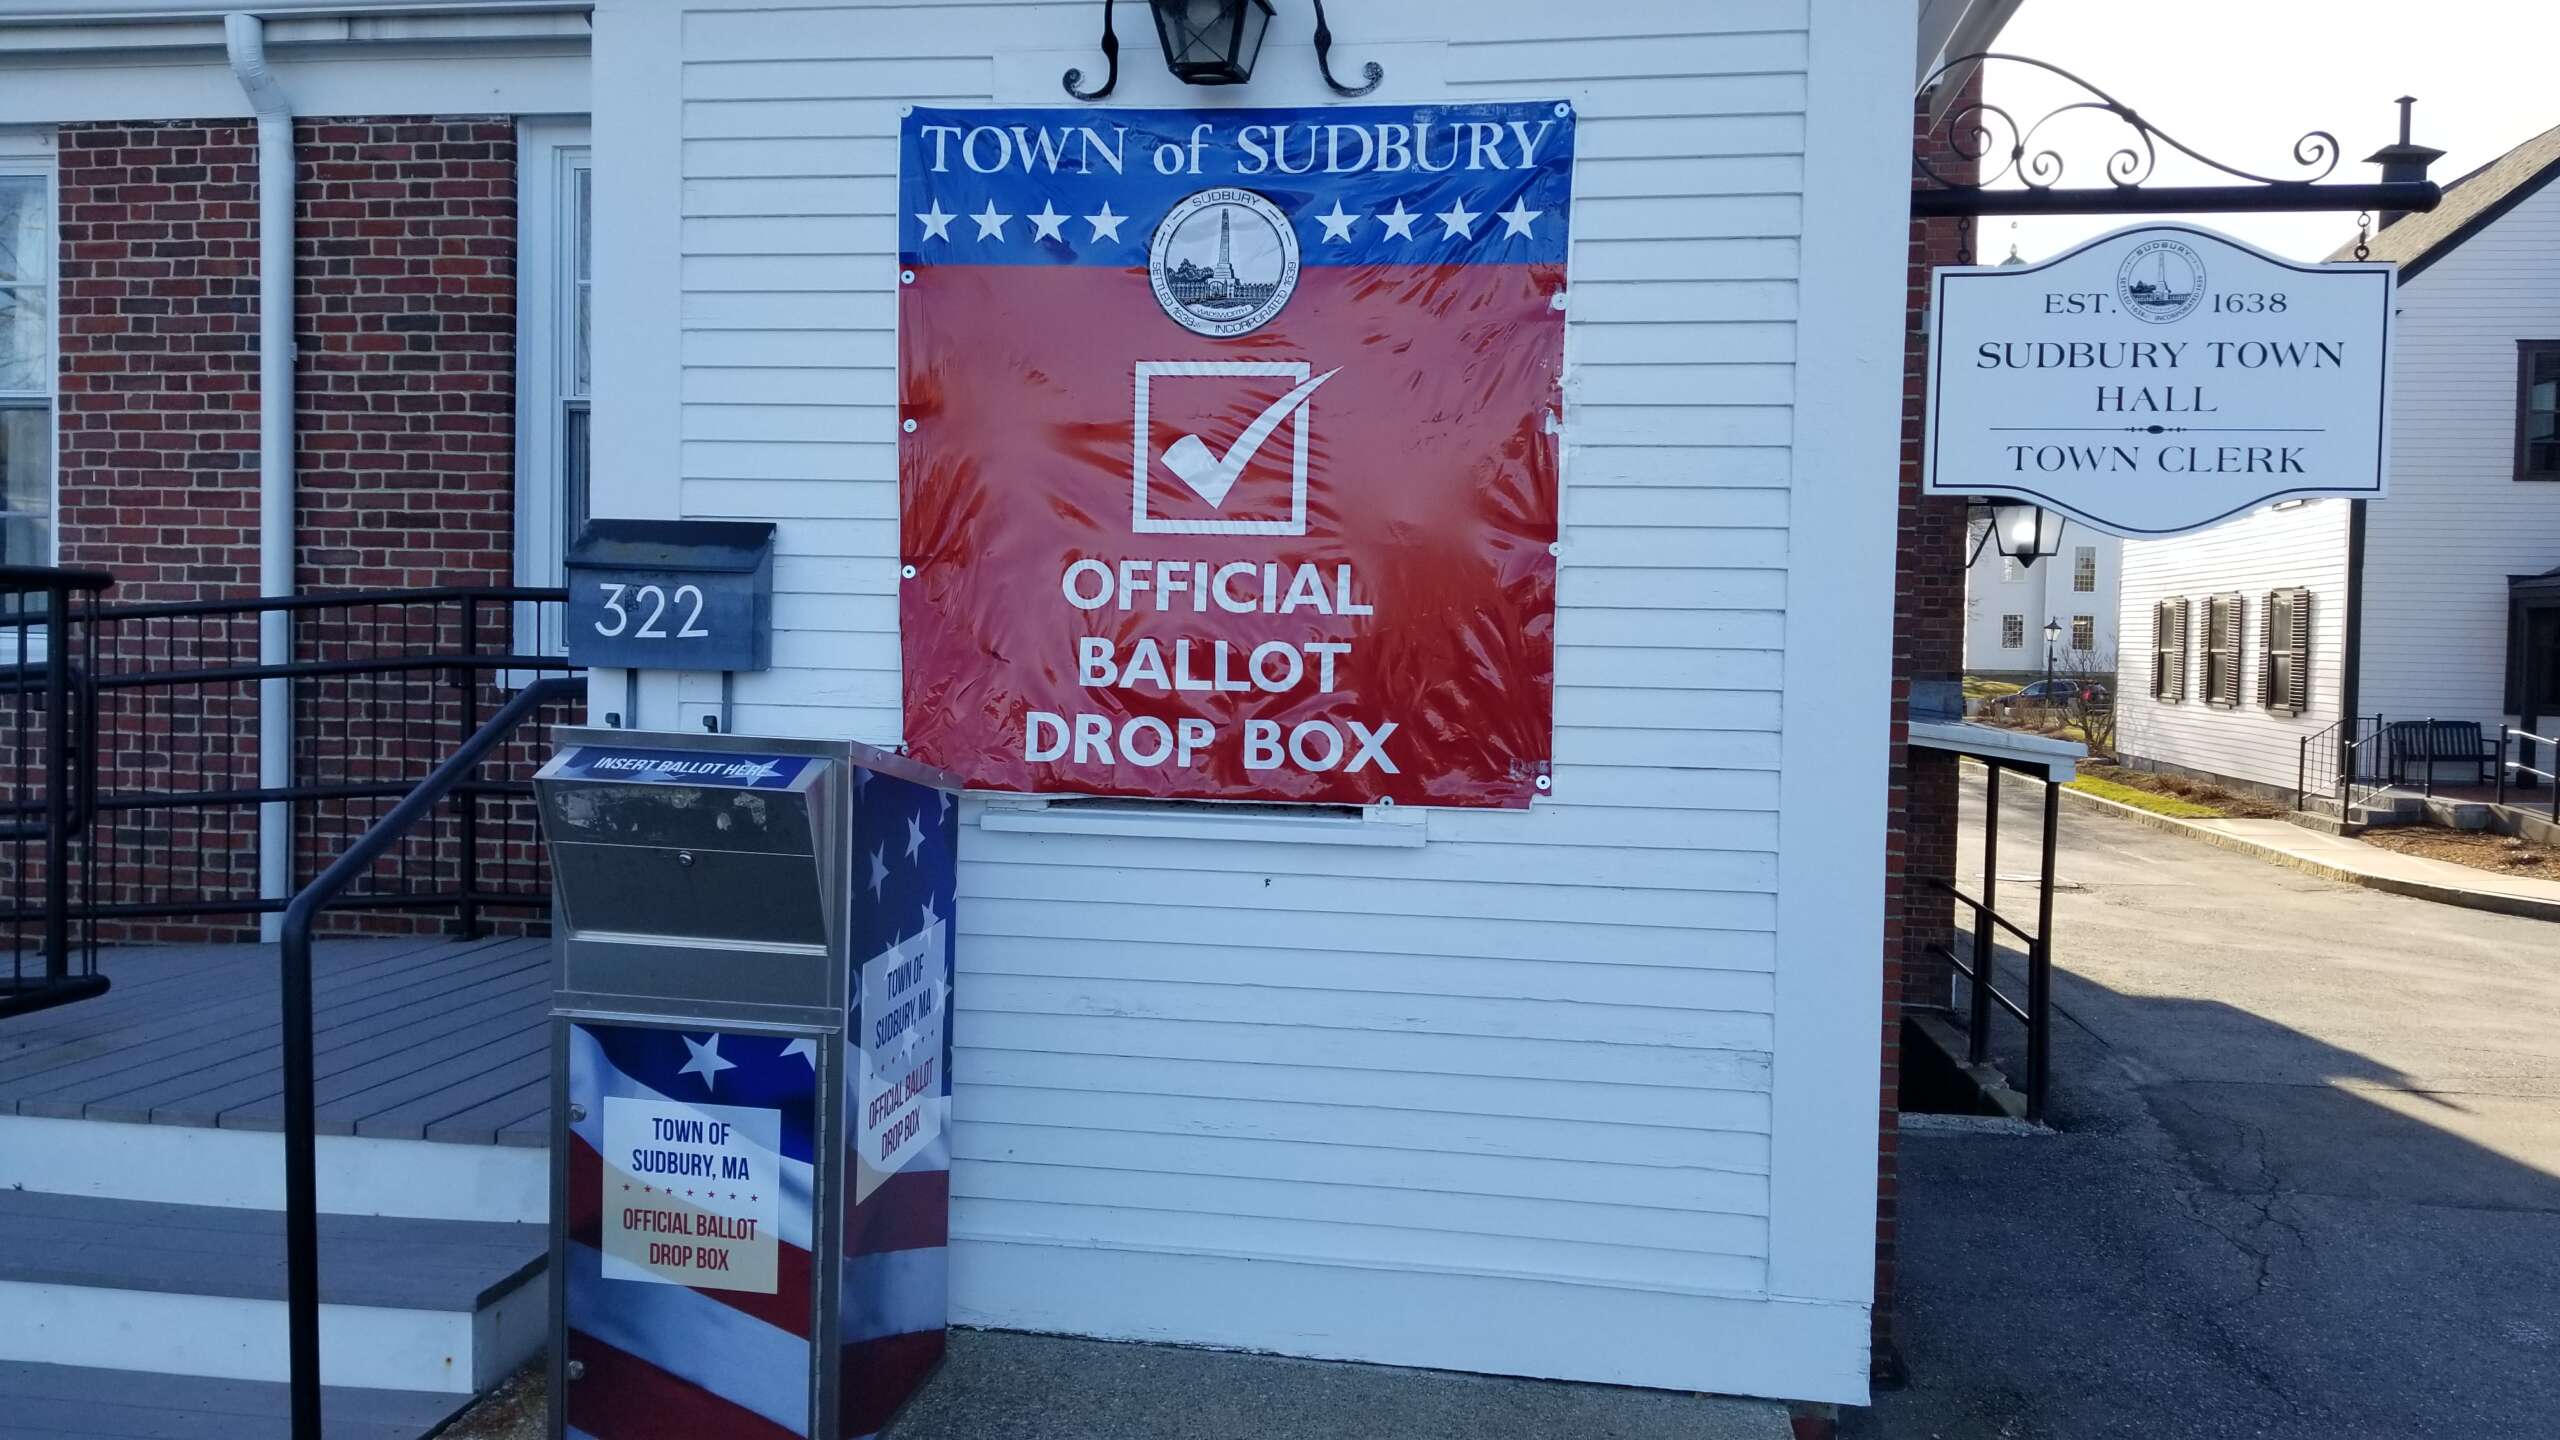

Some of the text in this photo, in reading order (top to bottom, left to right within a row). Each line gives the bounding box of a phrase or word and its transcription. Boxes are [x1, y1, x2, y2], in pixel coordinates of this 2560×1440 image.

[921, 119, 1554, 176] TOWN of SUDBURY
[1192, 190, 1261, 208] SUDBURY
[2136, 241, 2191, 256] SUDBURY
[1152, 261, 1174, 308] SETTLED
[1214, 261, 1297, 334] INCORPORATED 1639
[2045, 293, 2116, 314] EST.
[2213, 292, 2288, 314] 1638
[1976, 341, 2345, 369] SUDBURY TOWN
[2096, 386, 2218, 412] HALL
[2006, 445, 2306, 474] TOWN CLERK
[1062, 558, 1374, 616] OFFICIAL
[594, 583, 709, 639] 322
[1079, 636, 1352, 694] BALLOT
[1024, 711, 1400, 774] DROP BOX
[593, 756, 773, 777] INSERT BALLOT HERE
[887, 953, 925, 1001] TOWN OF
[875, 988, 931, 1049] SUDBURY, MA
[868, 1058, 934, 1130] OFFICIAL BALLOT
[652, 1117, 731, 1146] TOWN OF
[881, 1106, 921, 1162] DROP BOX
[632, 1148, 750, 1181] SUDBURY, MA
[623, 1207, 758, 1241] OFFICIAL BALLOT
[649, 1243, 730, 1271] DROP BOX
